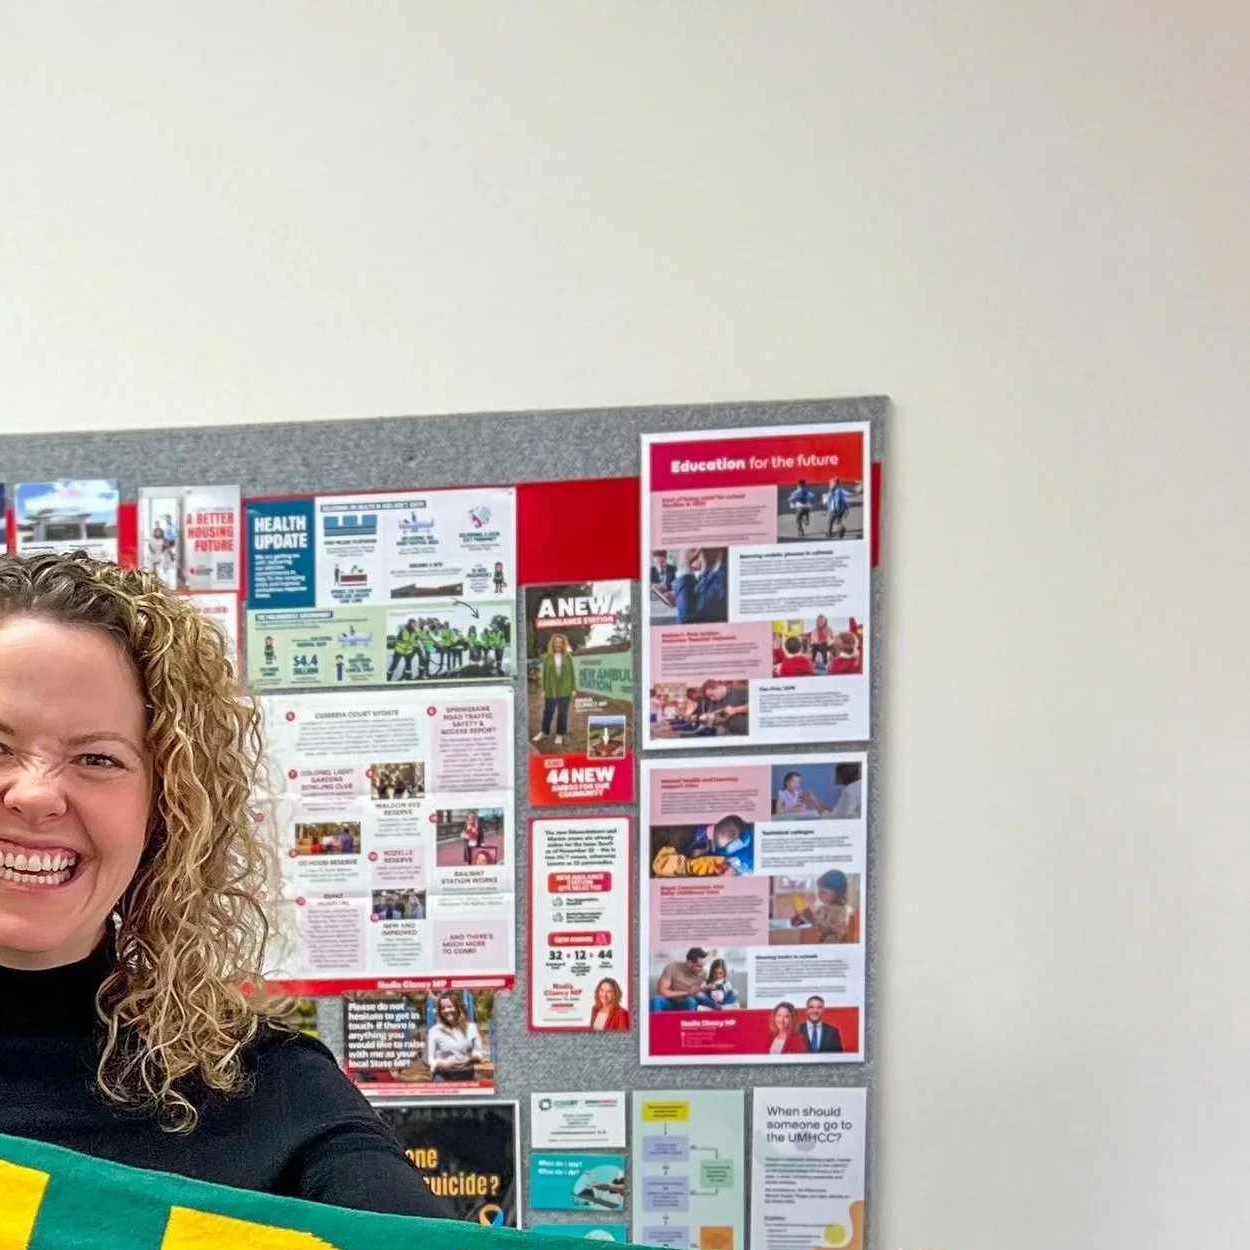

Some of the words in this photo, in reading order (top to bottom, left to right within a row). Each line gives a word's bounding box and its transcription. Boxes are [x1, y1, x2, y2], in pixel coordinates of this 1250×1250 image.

[671, 459, 745, 473] Education
[750, 457, 768, 469] for
[772, 455, 794, 468] the
[797, 454, 839, 467] future
[186, 514, 192, 524] A
[196, 512, 234, 524] BETTER
[254, 515, 306, 532] HEALTH
[187, 526, 233, 538] HOUSING
[194, 540, 233, 551] FUTURE
[254, 533, 307, 550] UPDATE
[537, 598, 556, 618] A
[558, 596, 614, 617] NEW
[293, 654, 318, 667] $4.4
[546, 769, 569, 784] 44
[572, 765, 615, 783] NEW
[549, 951, 563, 960] 32
[575, 950, 586, 960] 12
[598, 950, 612, 959] 44
[378, 980, 401, 989] Nadia
[403, 980, 431, 989] Clancy
[433, 979, 447, 988] MP
[348, 1003, 376, 1011] Please
[348, 1012, 383, 1020] hesitate
[395, 1012, 409, 1022] get
[348, 1022, 373, 1030] touch
[376, 1021, 382, 1029] if
[408, 1021, 416, 1029] is
[348, 1031, 387, 1041] anything
[404, 1040, 425, 1048] raise
[396, 1051, 417, 1059] your
[348, 1060, 369, 1068] local
[767, 1106, 799, 1117] When
[802, 1105, 841, 1117] should
[767, 1121, 820, 1130] someone
[823, 1121, 837, 1132] go
[841, 1120, 852, 1130] to
[767, 1133, 785, 1143] the
[788, 1132, 842, 1143] UMHCC?
